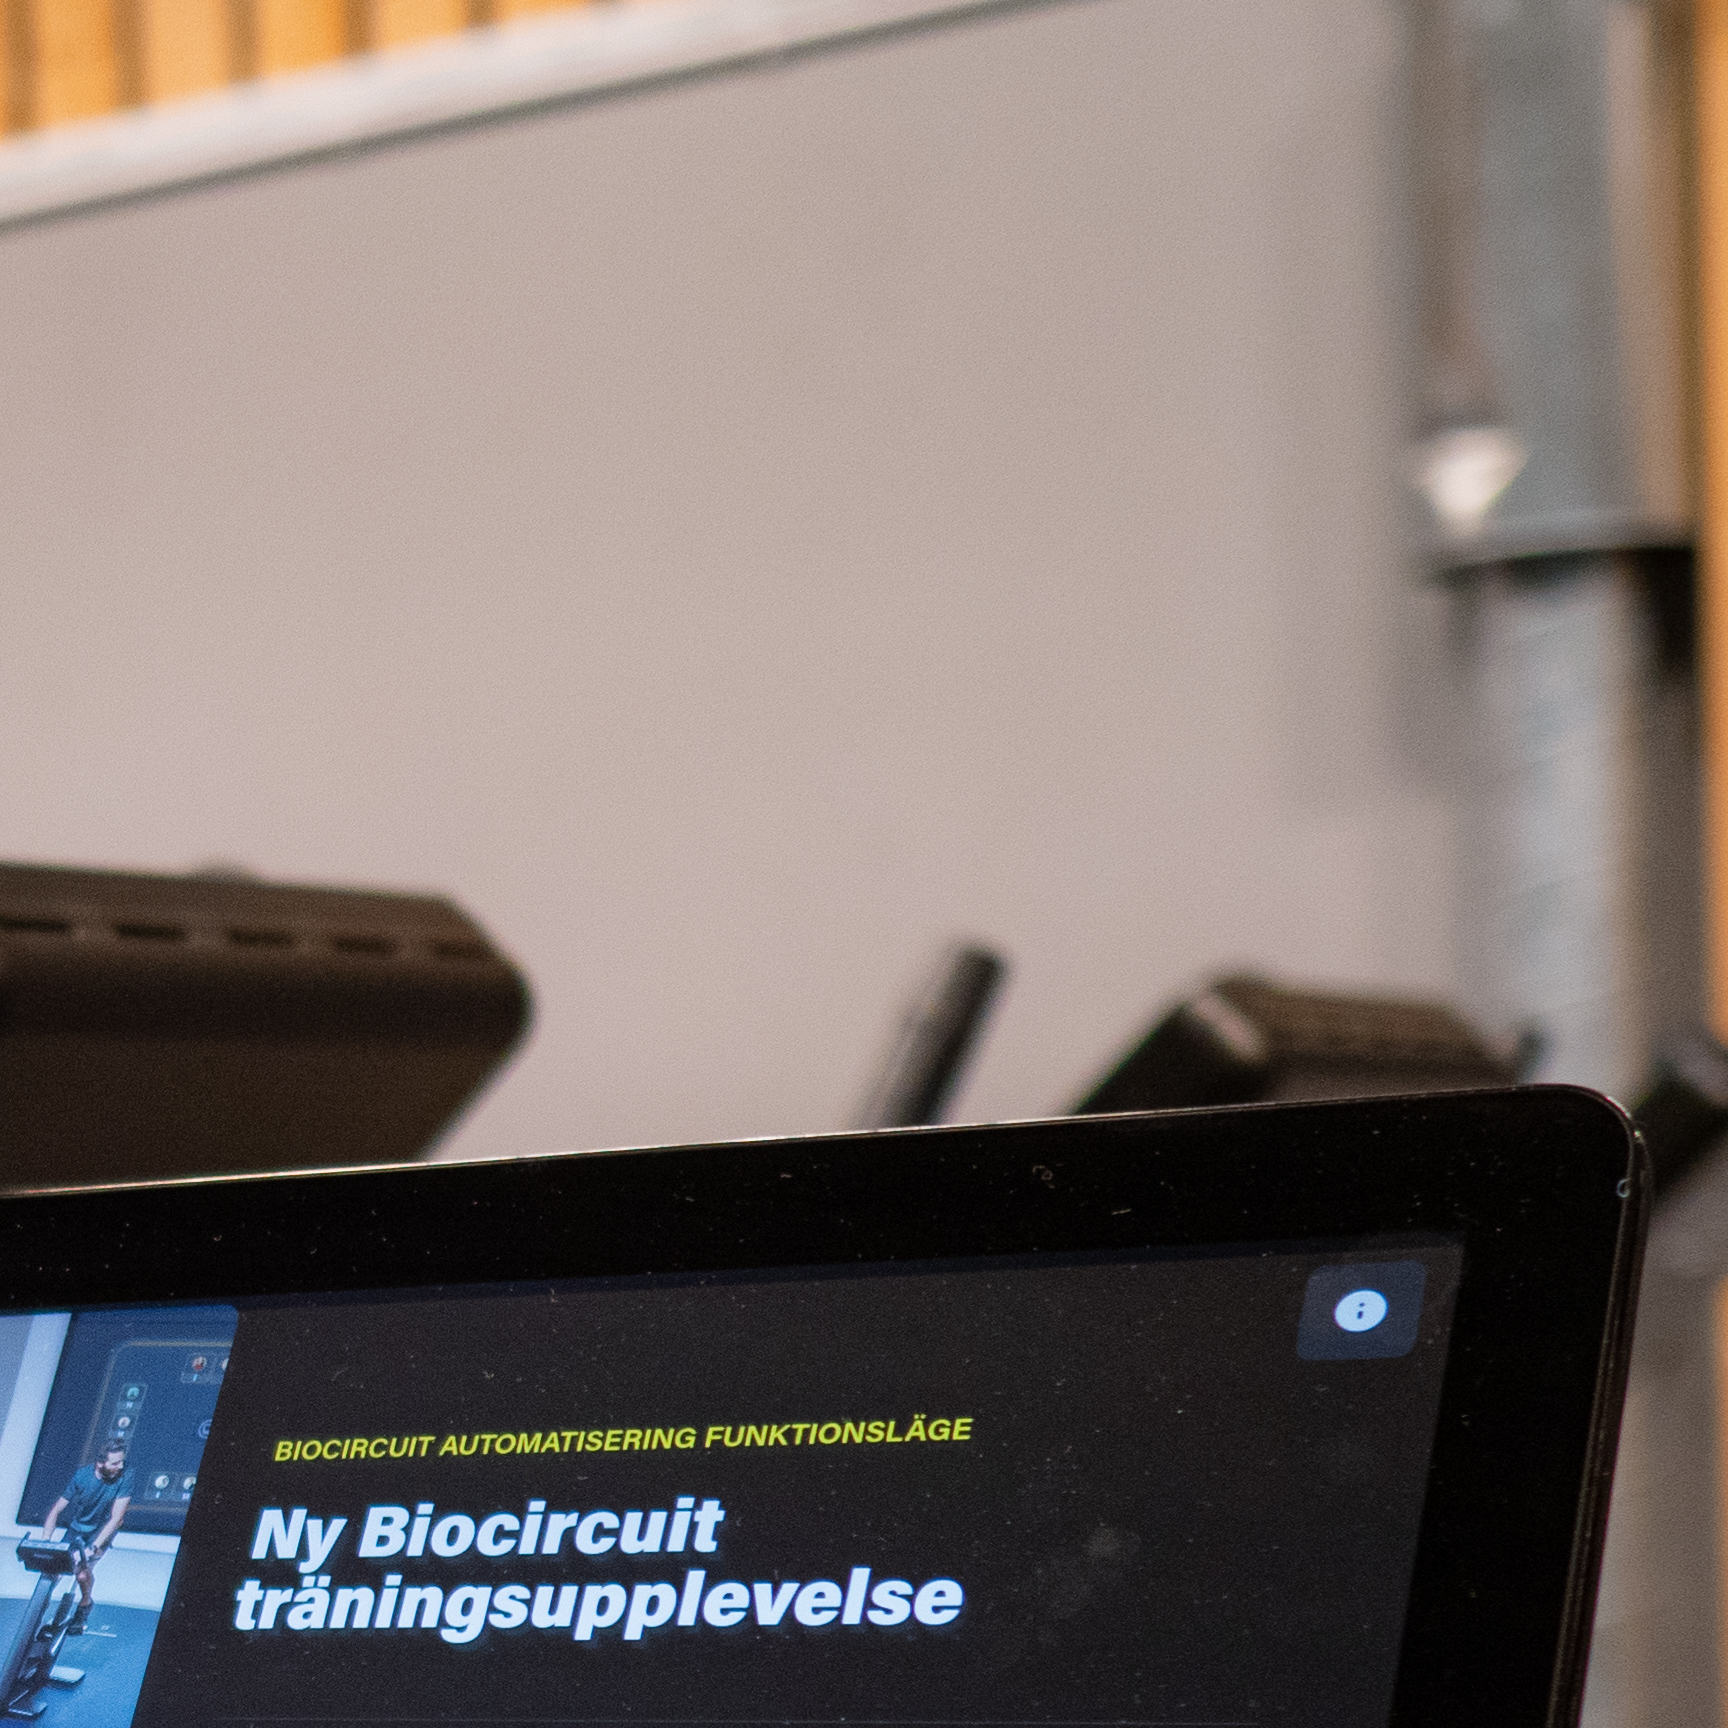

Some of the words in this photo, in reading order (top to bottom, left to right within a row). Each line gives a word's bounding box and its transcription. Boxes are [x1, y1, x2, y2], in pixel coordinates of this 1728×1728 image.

[274, 1436, 435, 1462] BIOCIRCUIT
[439, 1427, 697, 1456] AUTOMATISERING
[704, 1413, 974, 1448] FUNKTIONSLÄGE
[250, 1507, 348, 1574] Ny
[358, 1496, 726, 1558] Biocircuit
[234, 1566, 965, 1643] träningsupplevelse
